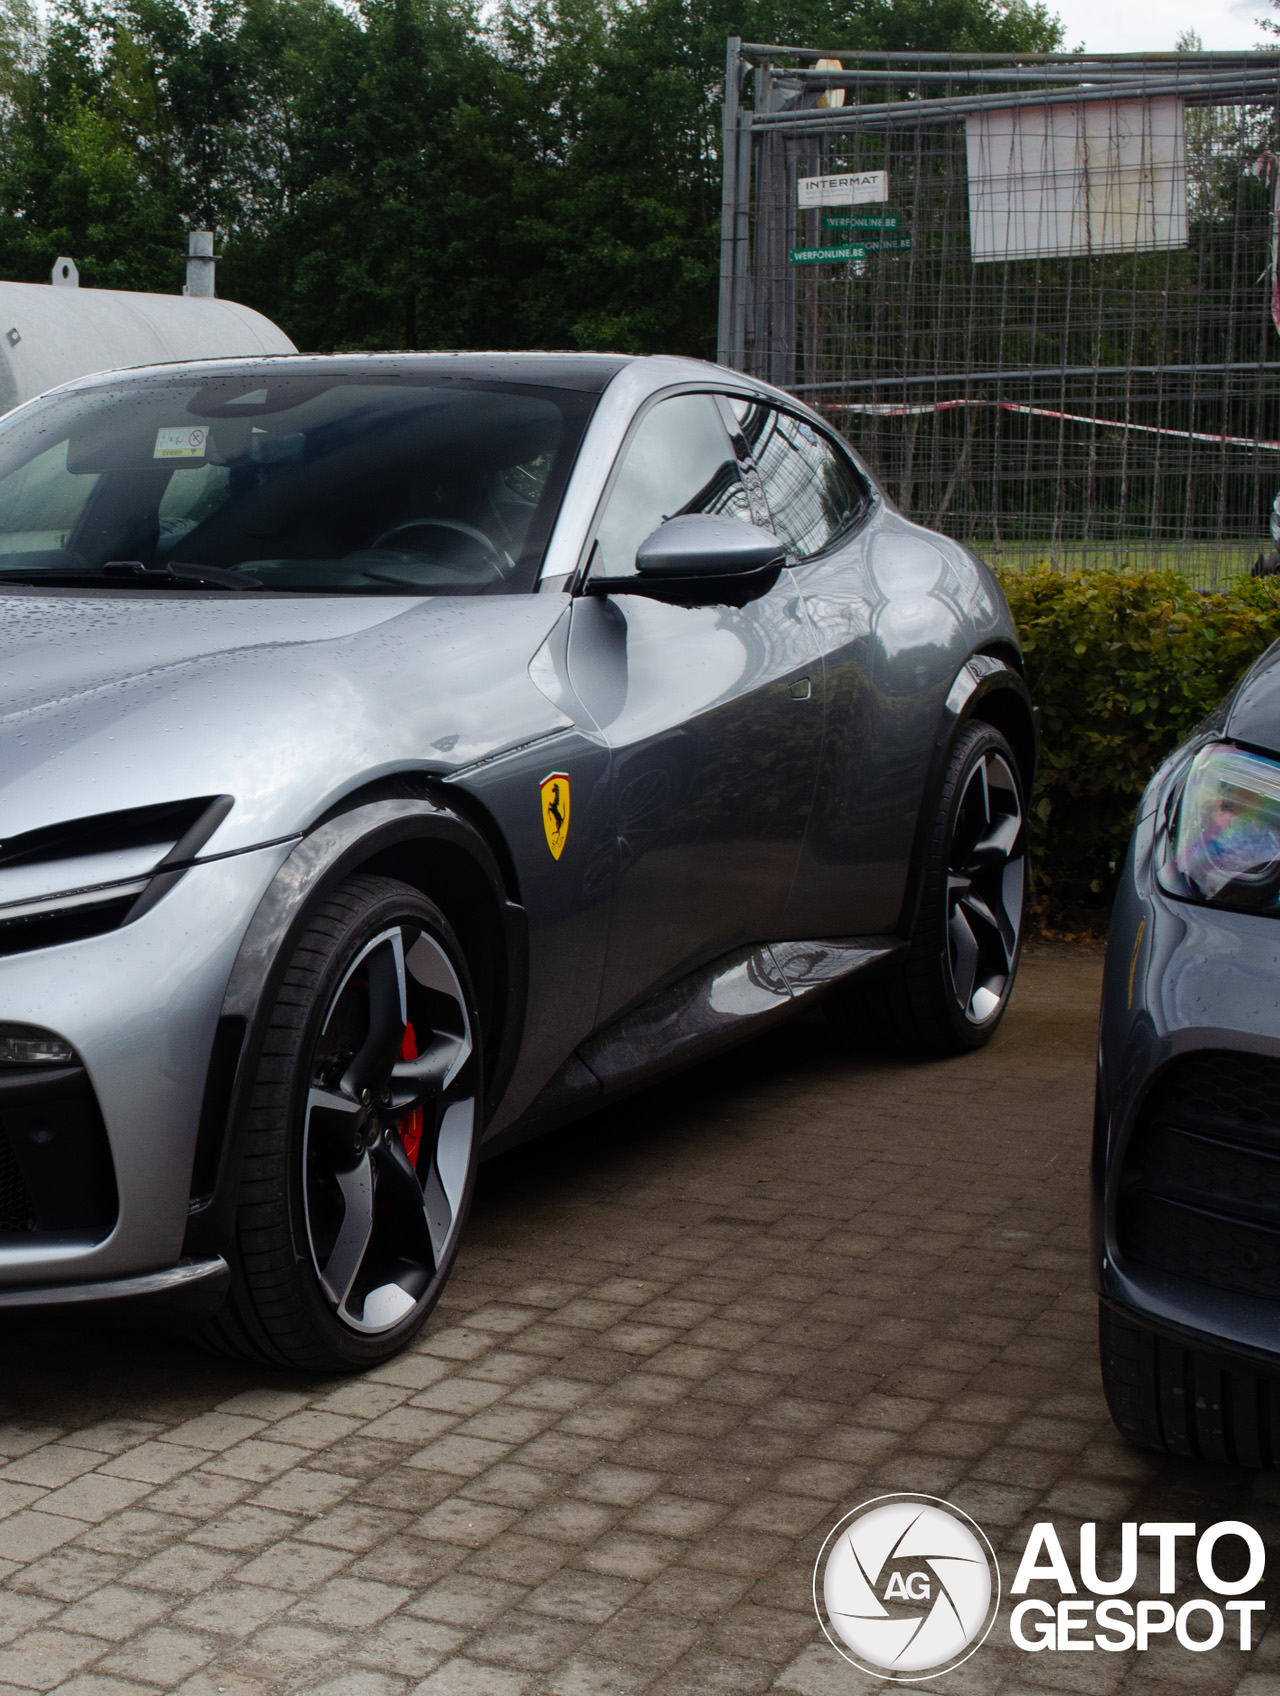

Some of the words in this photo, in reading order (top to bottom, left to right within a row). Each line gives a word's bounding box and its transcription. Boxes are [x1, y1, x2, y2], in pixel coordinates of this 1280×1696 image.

[805, 175, 878, 190] INTERMAT
[827, 217, 897, 227] WERFONLINE.BE
[793, 248, 865, 261] WERFONLINE.BE
